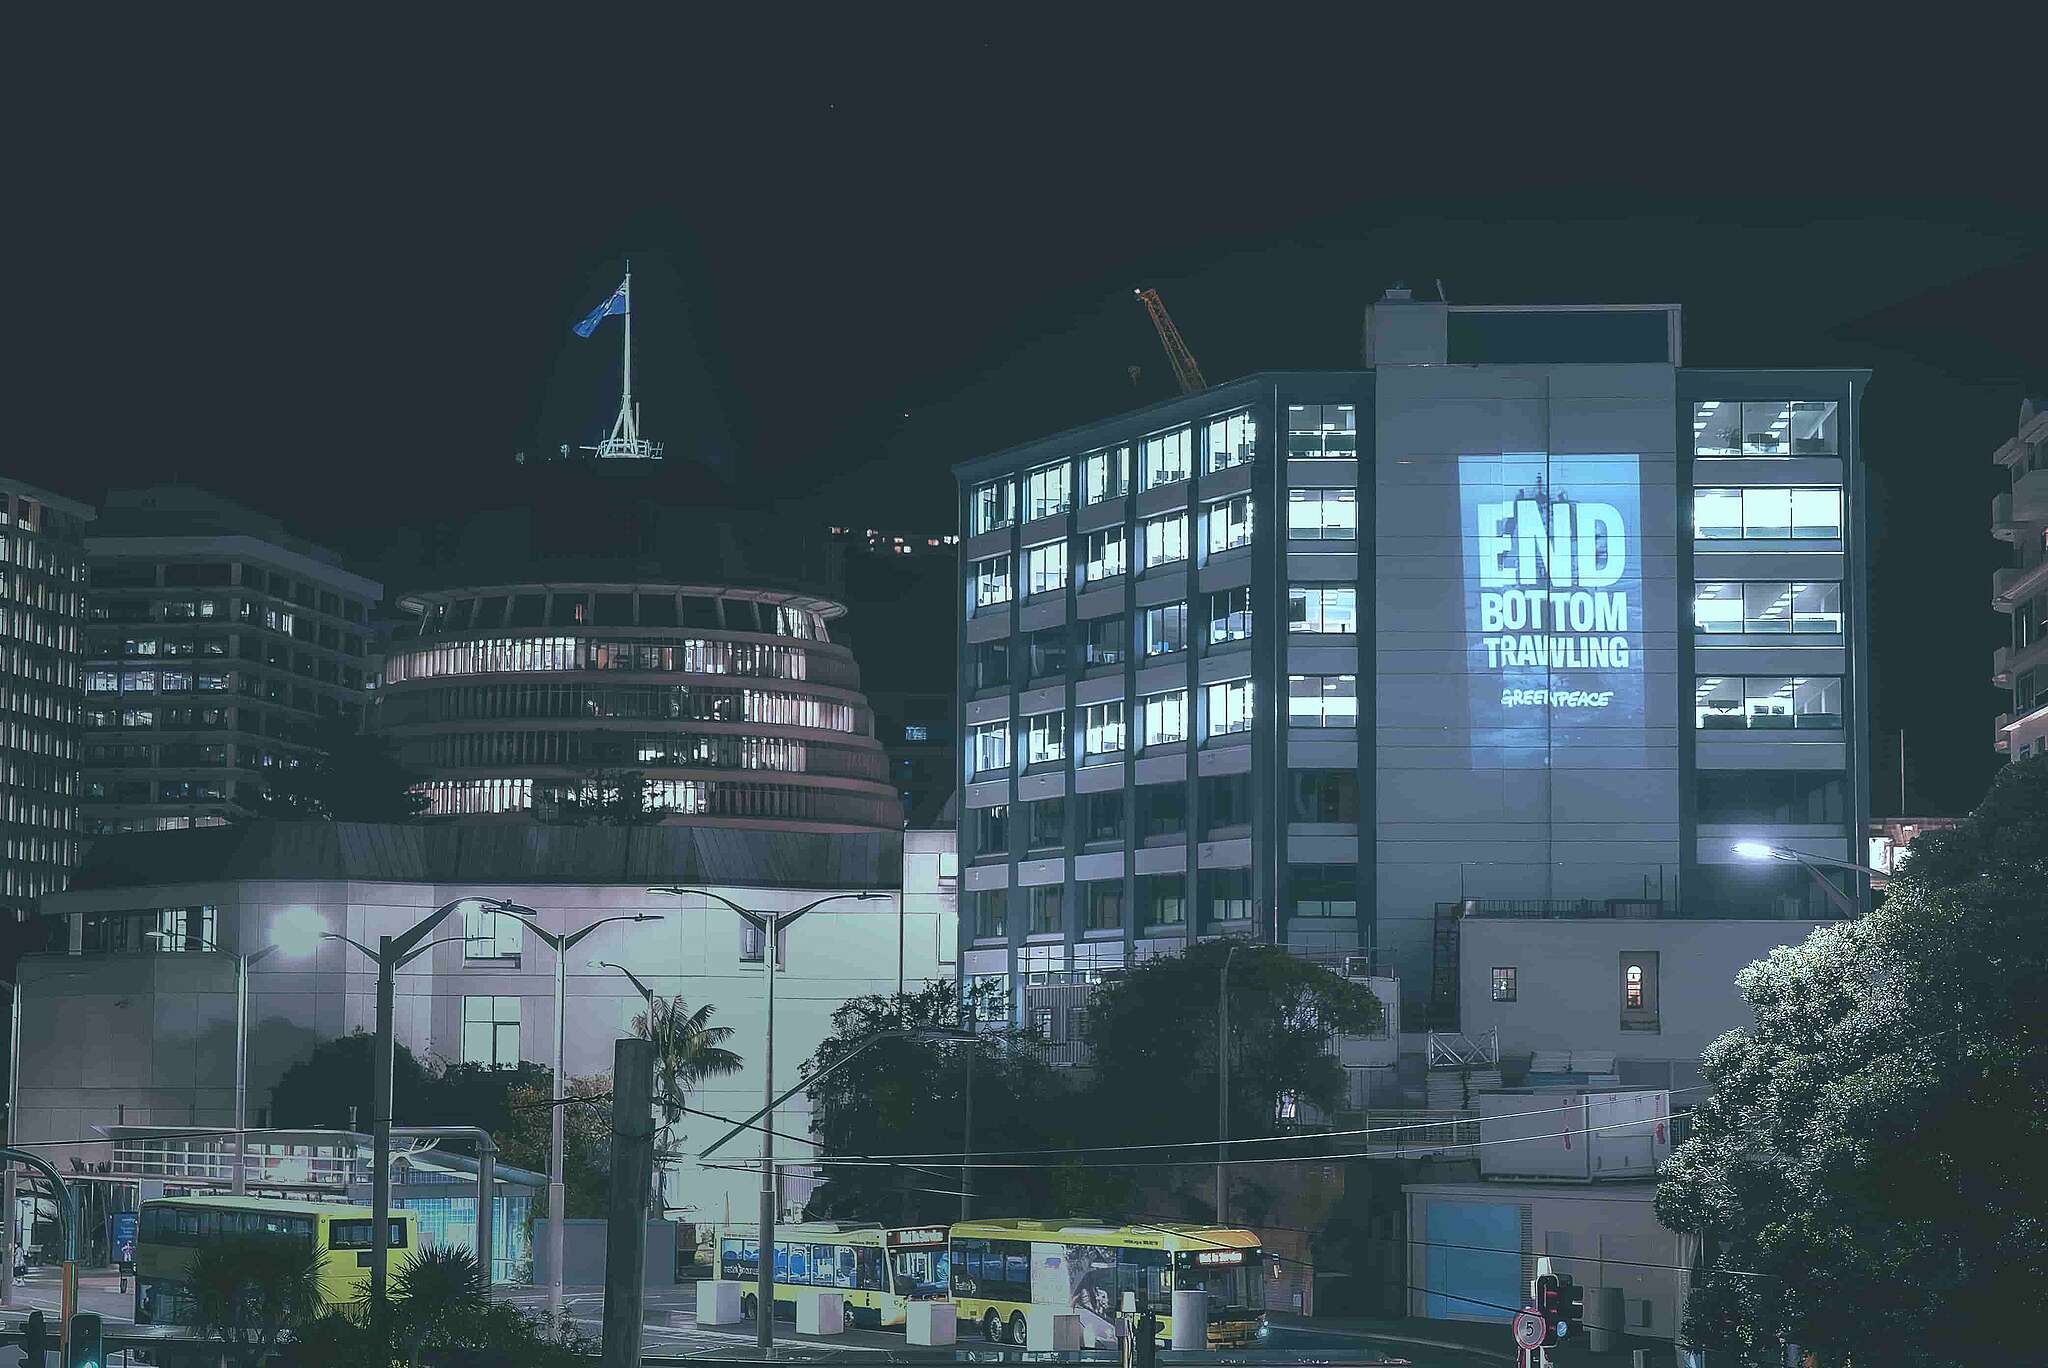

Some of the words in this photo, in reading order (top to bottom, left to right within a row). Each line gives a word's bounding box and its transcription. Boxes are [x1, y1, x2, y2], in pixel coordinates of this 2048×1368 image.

[1477, 500, 1626, 587] END
[1481, 590, 1628, 632] BOTTOM
[1483, 635, 1629, 668] TRAWLING
[1501, 689, 1613, 708] GREENPEACE
[1526, 1321, 1534, 1337] 5
